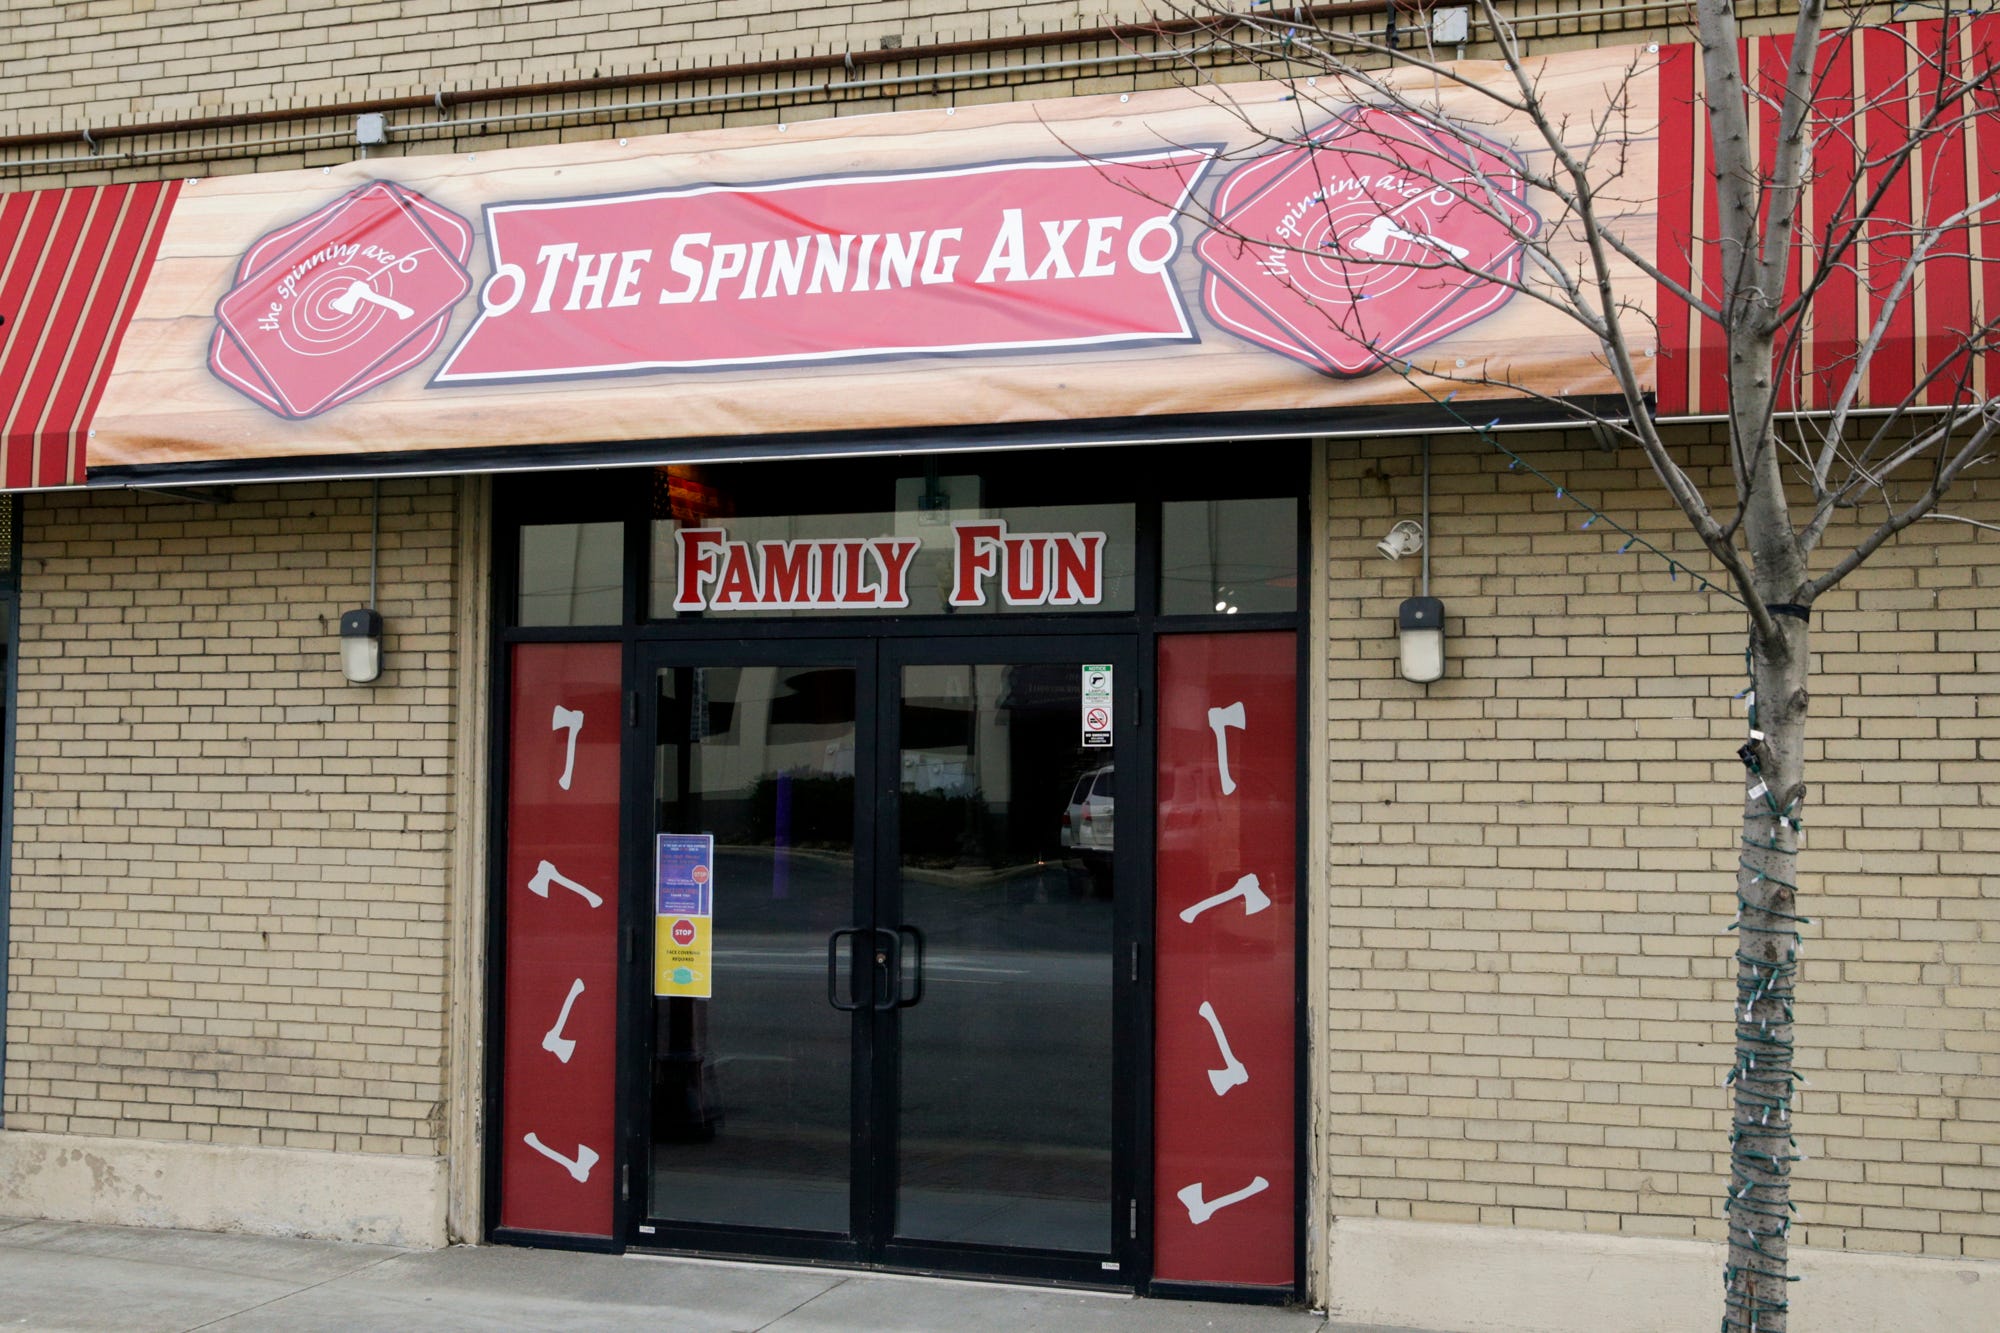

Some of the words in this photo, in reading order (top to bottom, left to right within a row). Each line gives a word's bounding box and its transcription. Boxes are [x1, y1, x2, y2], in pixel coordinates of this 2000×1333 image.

[257, 301, 283, 332] the
[277, 241, 361, 298] spinning
[361, 244, 396, 264] axe
[530, 242, 653, 313] THE
[658, 227, 963, 305] SPINNING
[974, 207, 1123, 283] AXE
[673, 527, 921, 611] FAMILY
[950, 518, 1107, 606] FUN
